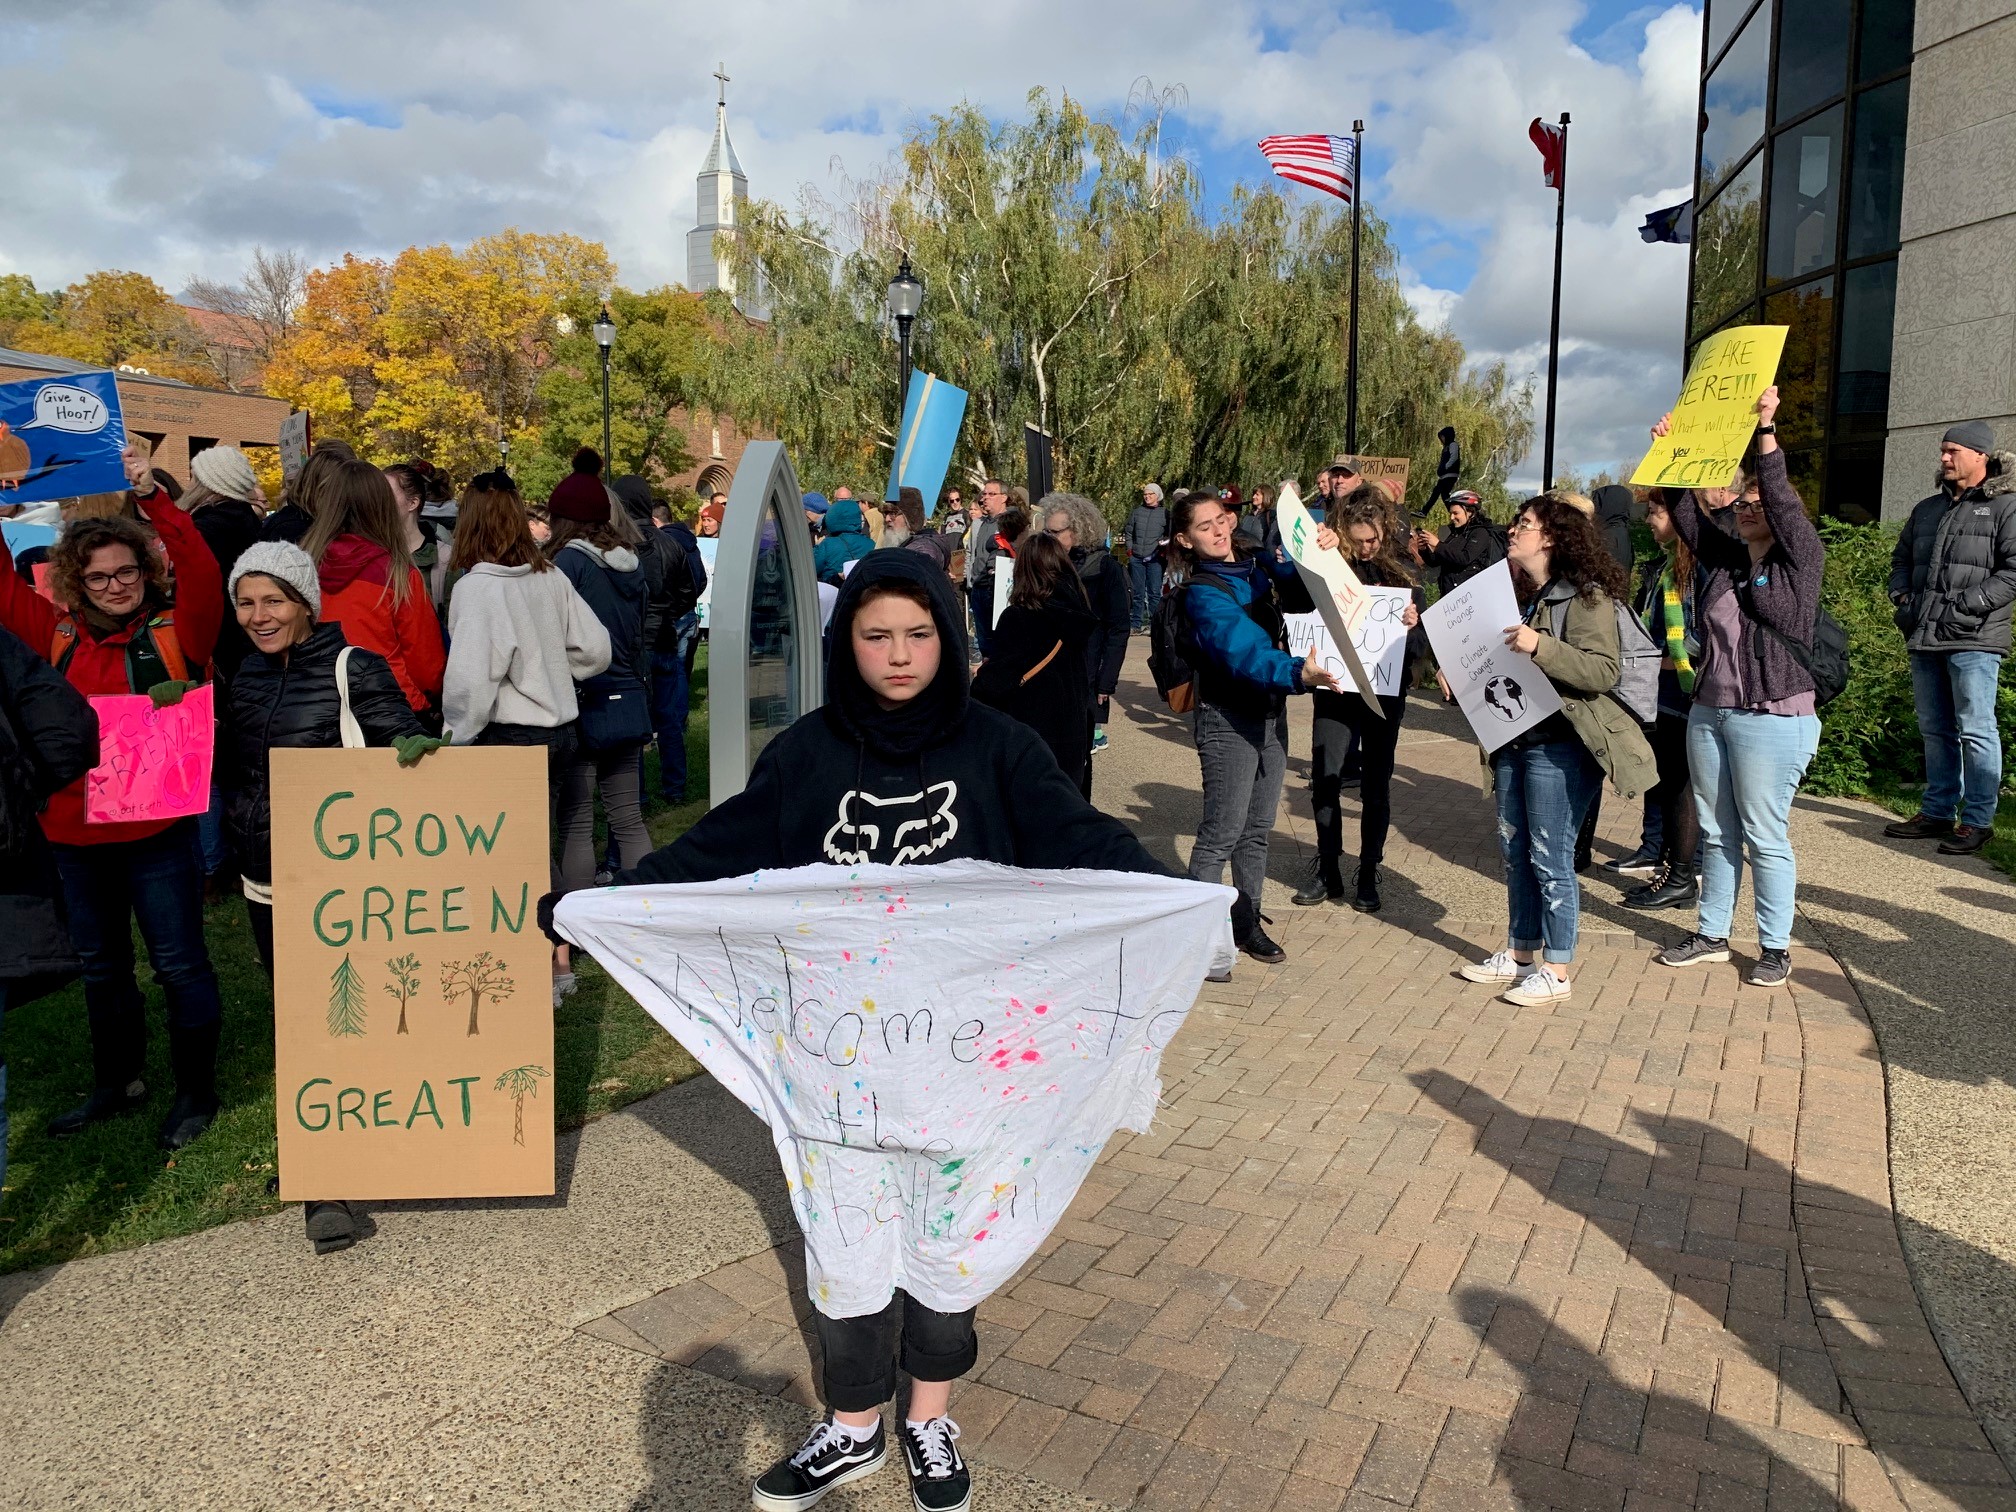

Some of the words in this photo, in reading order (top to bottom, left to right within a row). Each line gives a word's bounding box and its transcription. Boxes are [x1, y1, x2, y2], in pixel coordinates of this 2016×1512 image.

[1719, 339, 1756, 368] ARE
[43, 390, 72, 404] Give
[80, 394, 87, 404] a
[1677, 373, 1758, 407] HERE!!!
[1704, 414, 1723, 433] will
[1726, 414, 1736, 430] it
[1651, 440, 1666, 457] for
[1669, 446, 1691, 462] you
[1694, 446, 1706, 455] to
[1654, 457, 1739, 485] ACT???
[1333, 582, 1359, 617] OU
[1364, 594, 1405, 625] OR
[1443, 591, 1473, 617] Human
[1353, 626, 1386, 653] OU
[1460, 643, 1488, 669] Climate
[91, 692, 211, 796] FRIENDLY
[139, 799, 162, 812] Earth
[313, 790, 506, 861] GROW
[312, 881, 529, 948] GREEN
[594, 925, 985, 1067] Welcome
[1080, 937, 1187, 1058] to
[294, 1075, 481, 1133] GREAT
[820, 1090, 955, 1159] the
